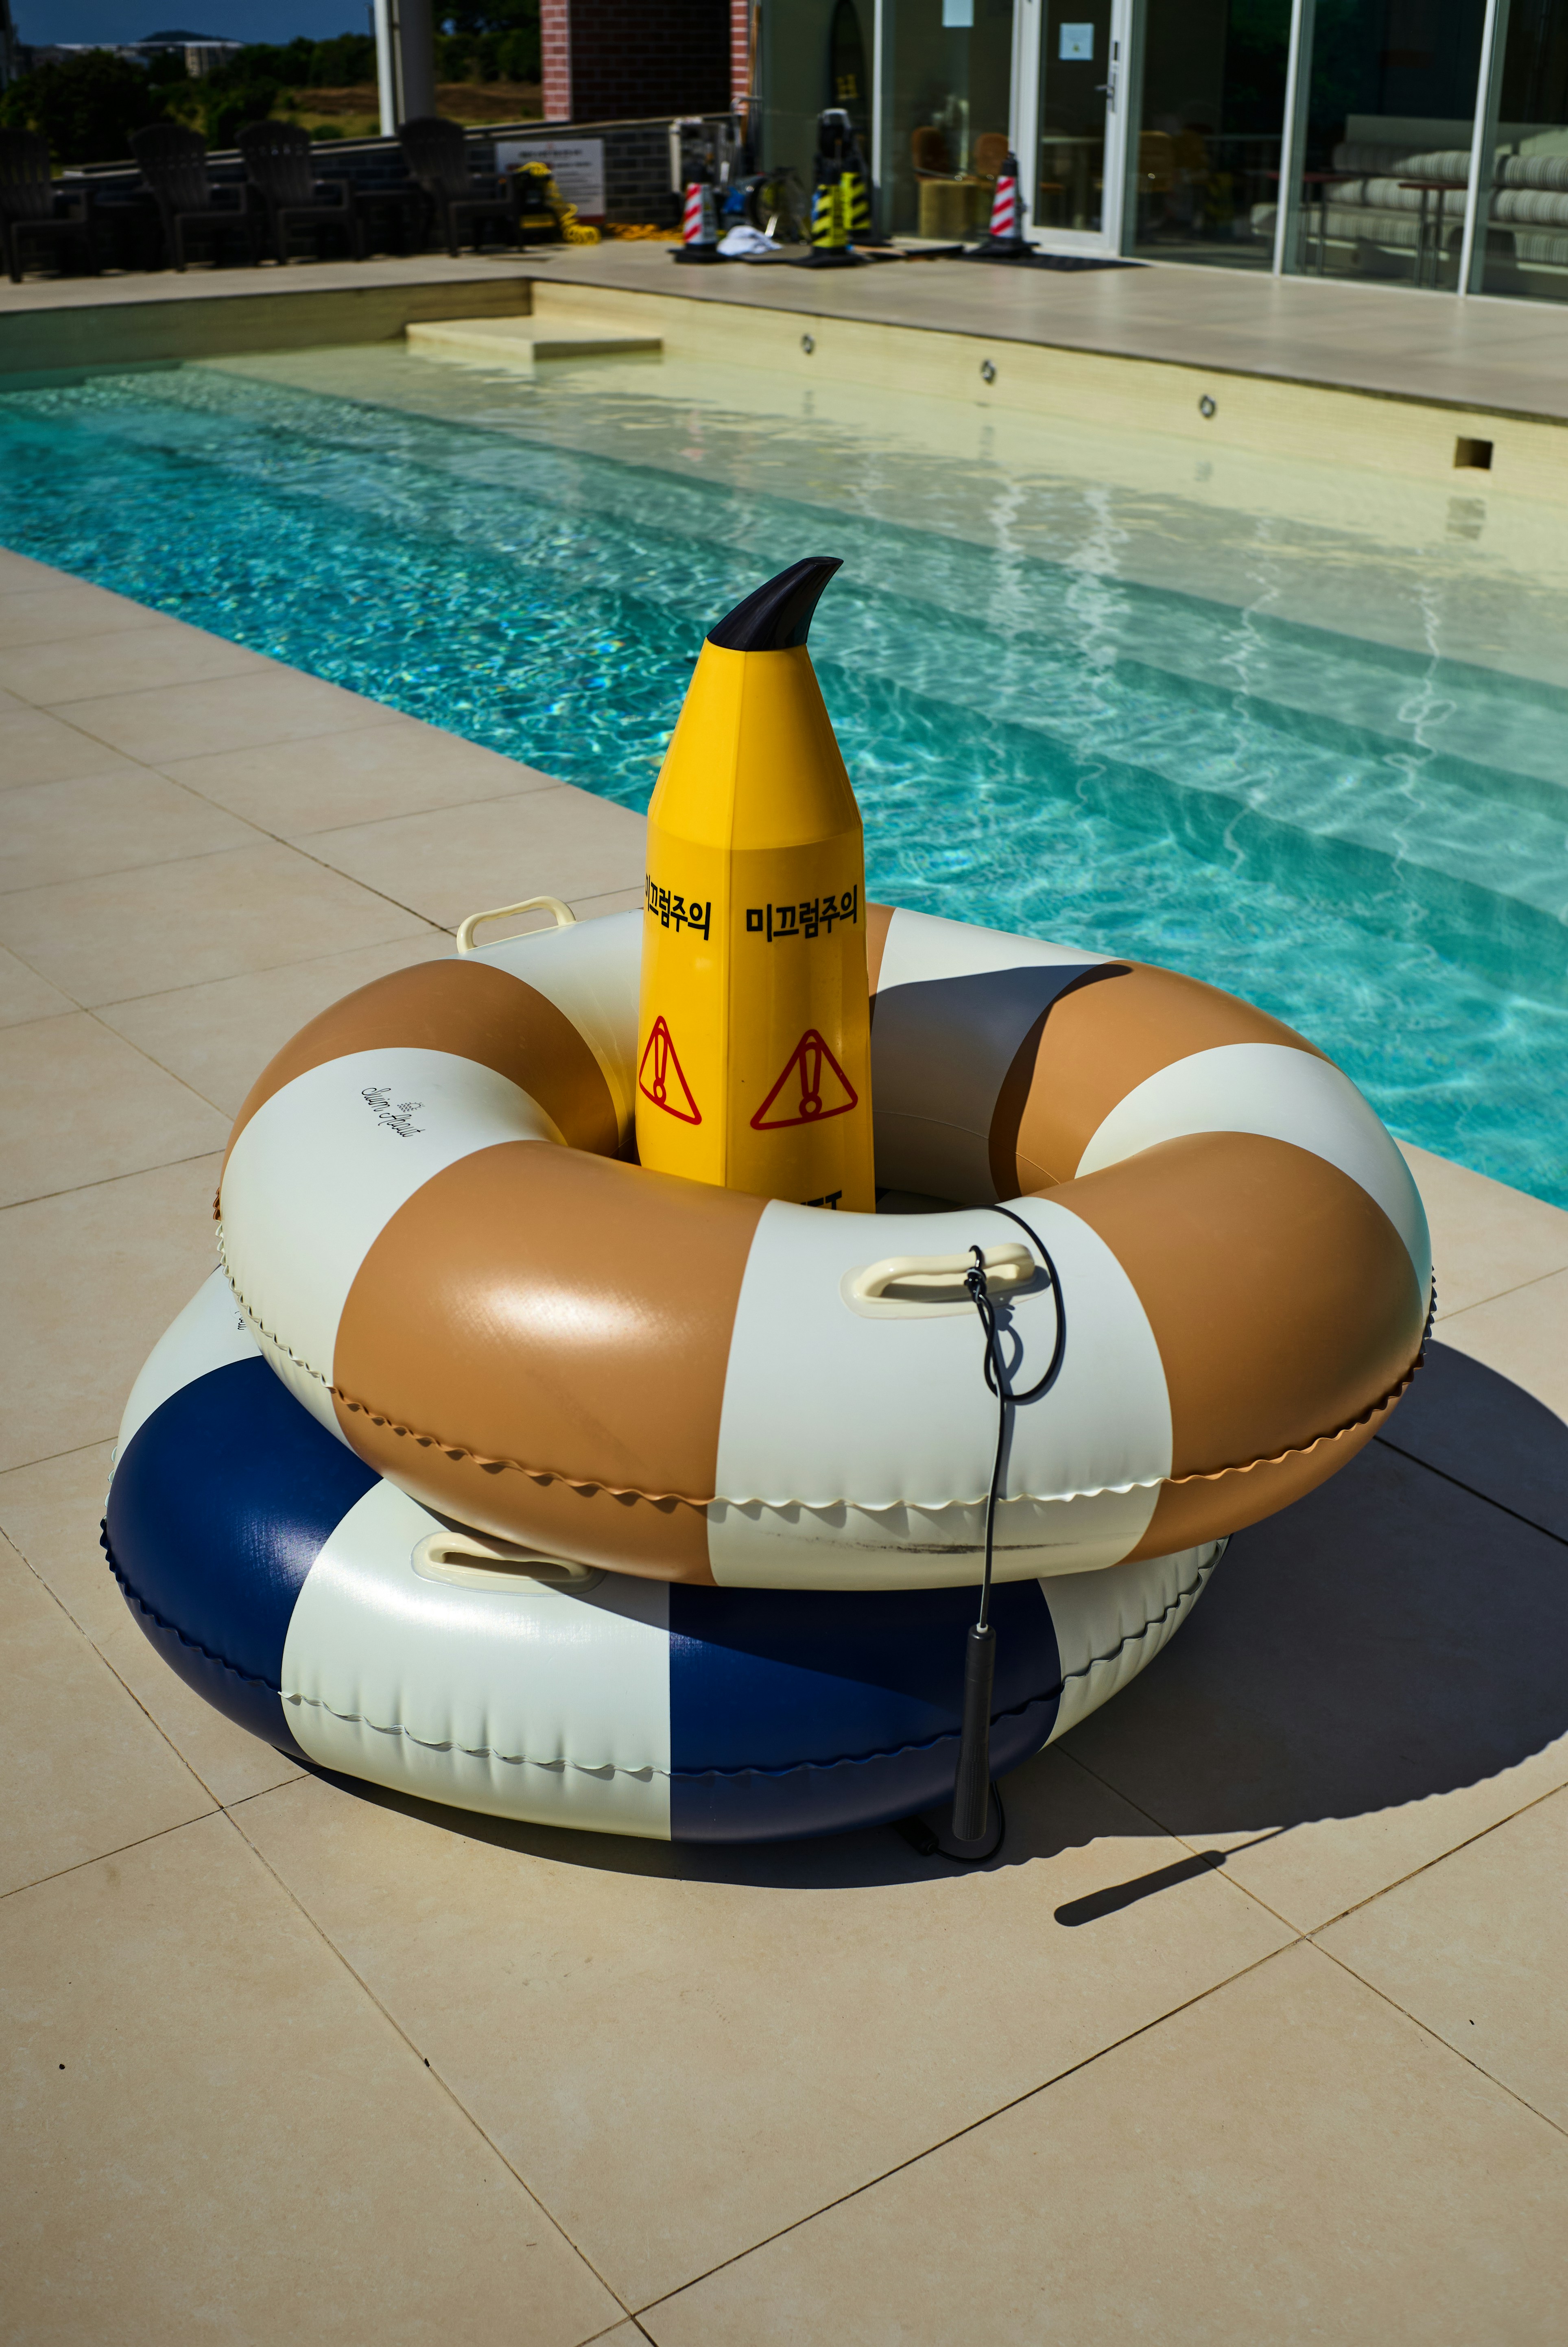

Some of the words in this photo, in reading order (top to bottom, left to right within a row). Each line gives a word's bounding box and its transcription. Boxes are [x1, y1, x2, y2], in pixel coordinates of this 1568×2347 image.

[645, 872, 711, 941] 미끄럼주의
[746, 884, 857, 942] 미끄럼주의
[361, 1087, 391, 1111] Swim
